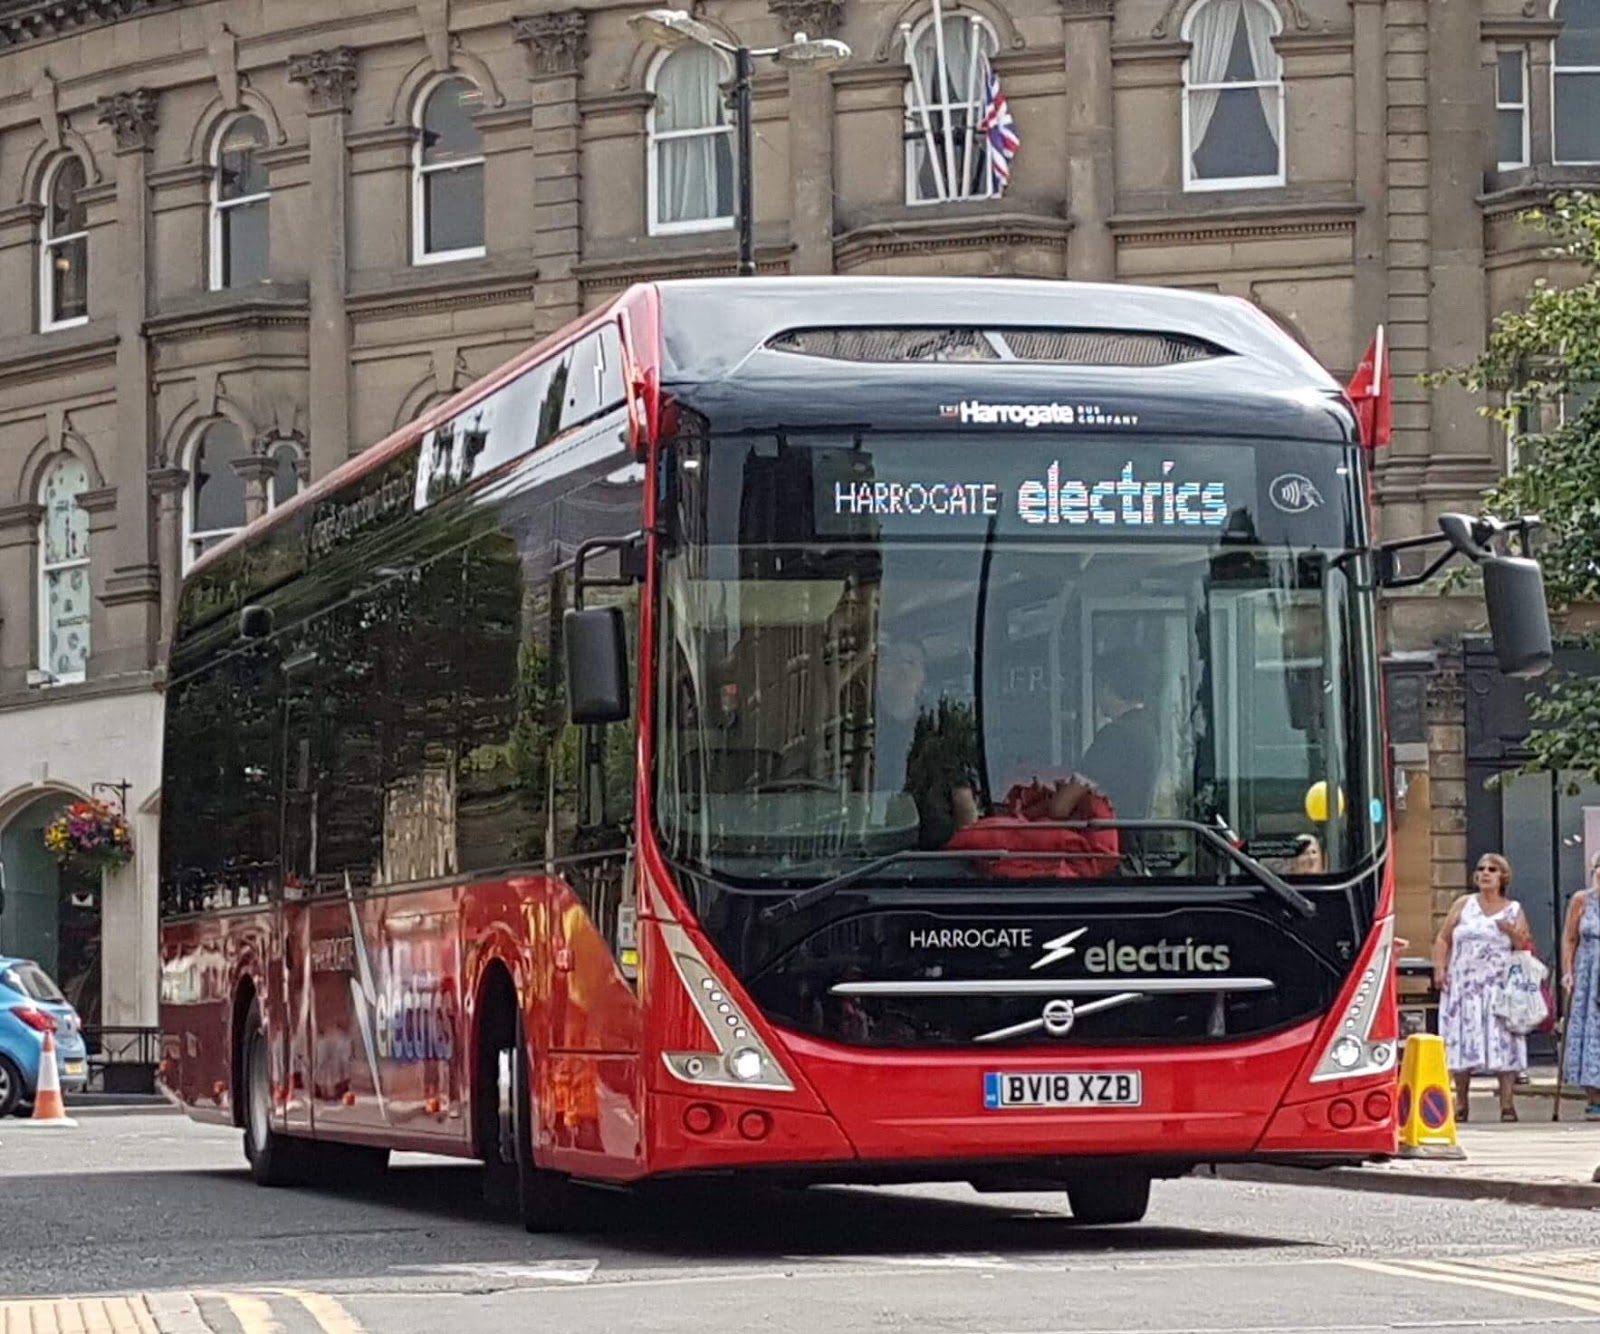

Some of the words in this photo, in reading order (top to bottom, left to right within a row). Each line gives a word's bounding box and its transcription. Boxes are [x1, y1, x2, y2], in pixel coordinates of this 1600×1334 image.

[960, 400, 1074, 427] Harrogate
[1077, 405, 1101, 415] BUS
[834, 481, 997, 514] HARROGATE
[1018, 460, 1227, 525] electrics
[909, 928, 1033, 949] HARROGATE
[1084, 937, 1230, 972] electrics
[1008, 1075, 1070, 1102] BV18
[1079, 1074, 1132, 1101] XZB
